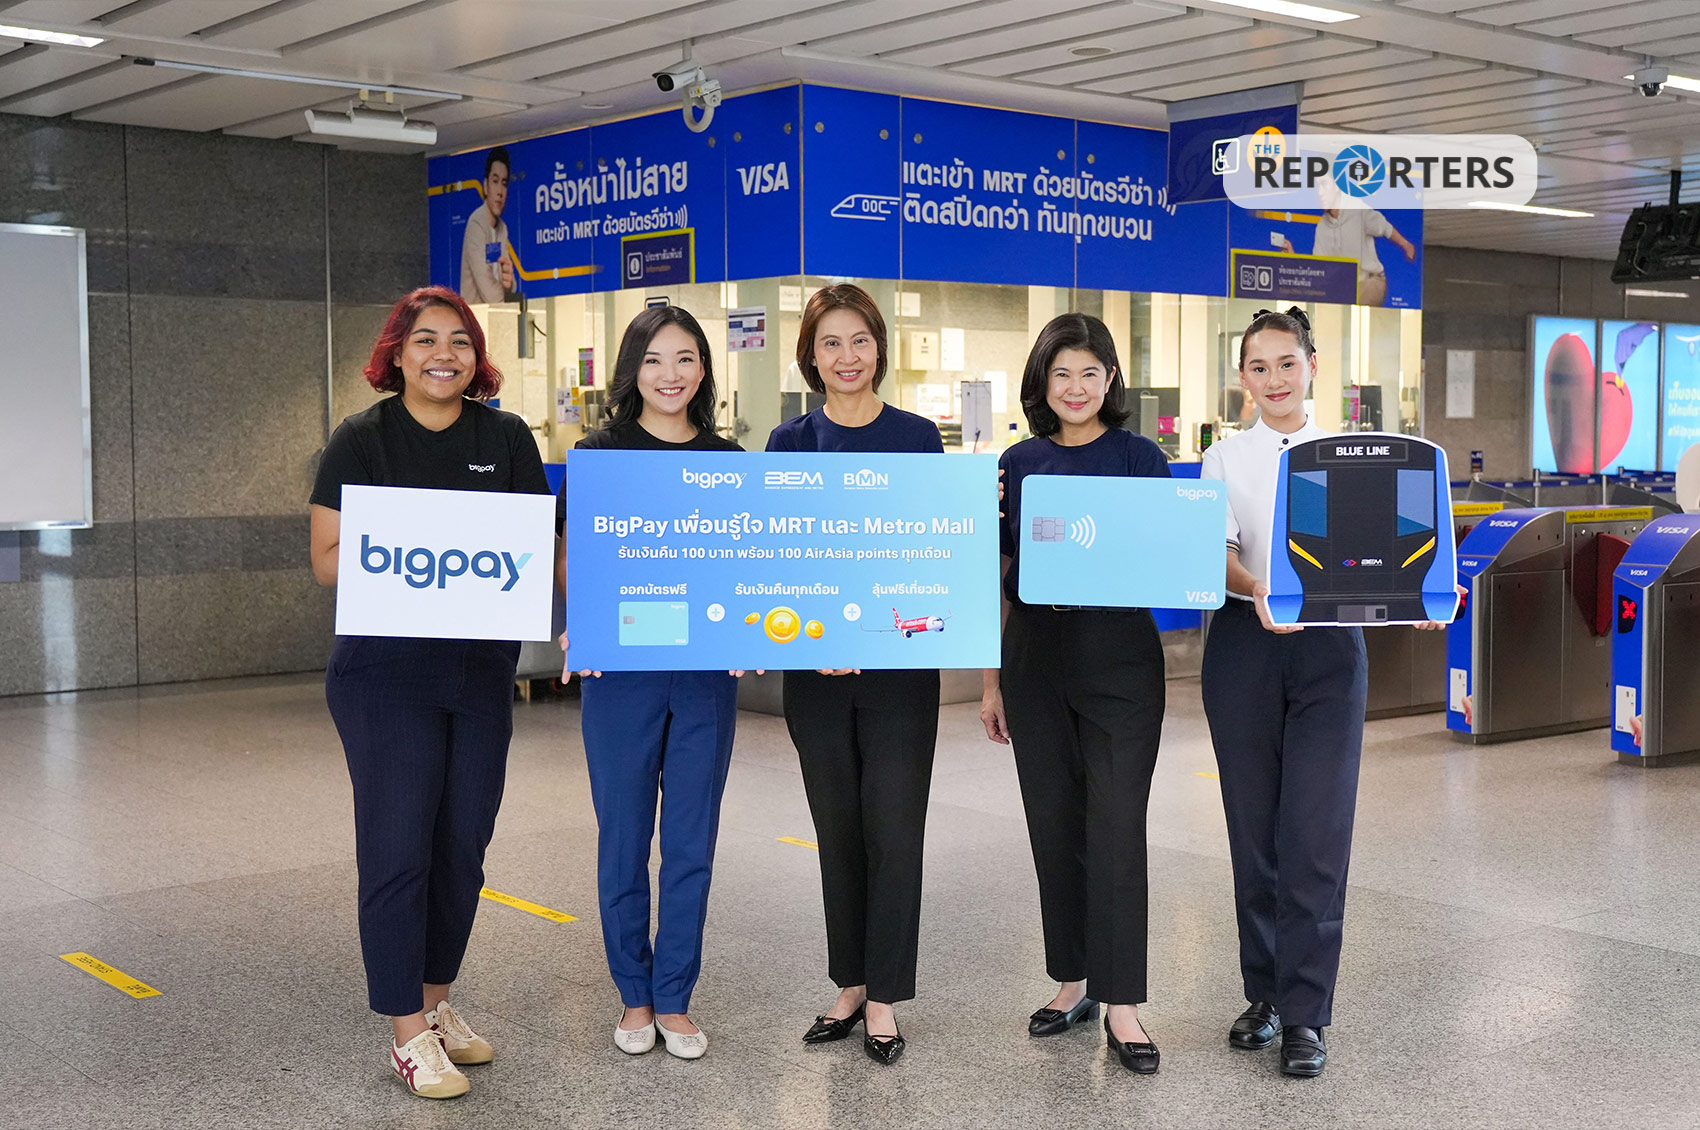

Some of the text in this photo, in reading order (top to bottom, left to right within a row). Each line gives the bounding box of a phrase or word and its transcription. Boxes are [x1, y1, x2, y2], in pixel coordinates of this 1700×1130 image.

[536, 157, 688, 213] ครั้งหน้าไม่สาย
[736, 161, 790, 196] VISA
[903, 157, 1153, 206] แตะเข้า MRT ด้วยบัตรวีซ่า
[536, 206, 675, 244] แตะเข้า MRT ด้วยบัตรวีซ่า
[903, 192, 1153, 244] ติดสปีดกว่า ทันทุกขบวน
[1335, 446, 1390, 457] BLUE LINE
[468, 463, 496, 473] bigpay
[682, 468, 747, 489] bigpay
[764, 471, 824, 486] BEM
[843, 468, 889, 487] BMN
[1176, 485, 1219, 501] bigpay
[593, 508, 975, 541] BigPay เพื่อนรู้ใจ MRT และ Metro Mall
[1489, 519, 1518, 529] VISA
[1656, 525, 1689, 536] VISA
[360, 534, 533, 592] bigpay
[618, 545, 952, 563] รับเงินคืน 100 บาท พร้อม 100 AirAsia points ทุกเดือน
[1630, 569, 1648, 577] VISA
[619, 583, 687, 596] ออกบัตรฟรี
[735, 582, 839, 599] รับเงินคืนทุกเดือน
[871, 580, 950, 599] ลุ้นฟรีเที่ยวบิน
[1185, 590, 1218, 603] VISA
